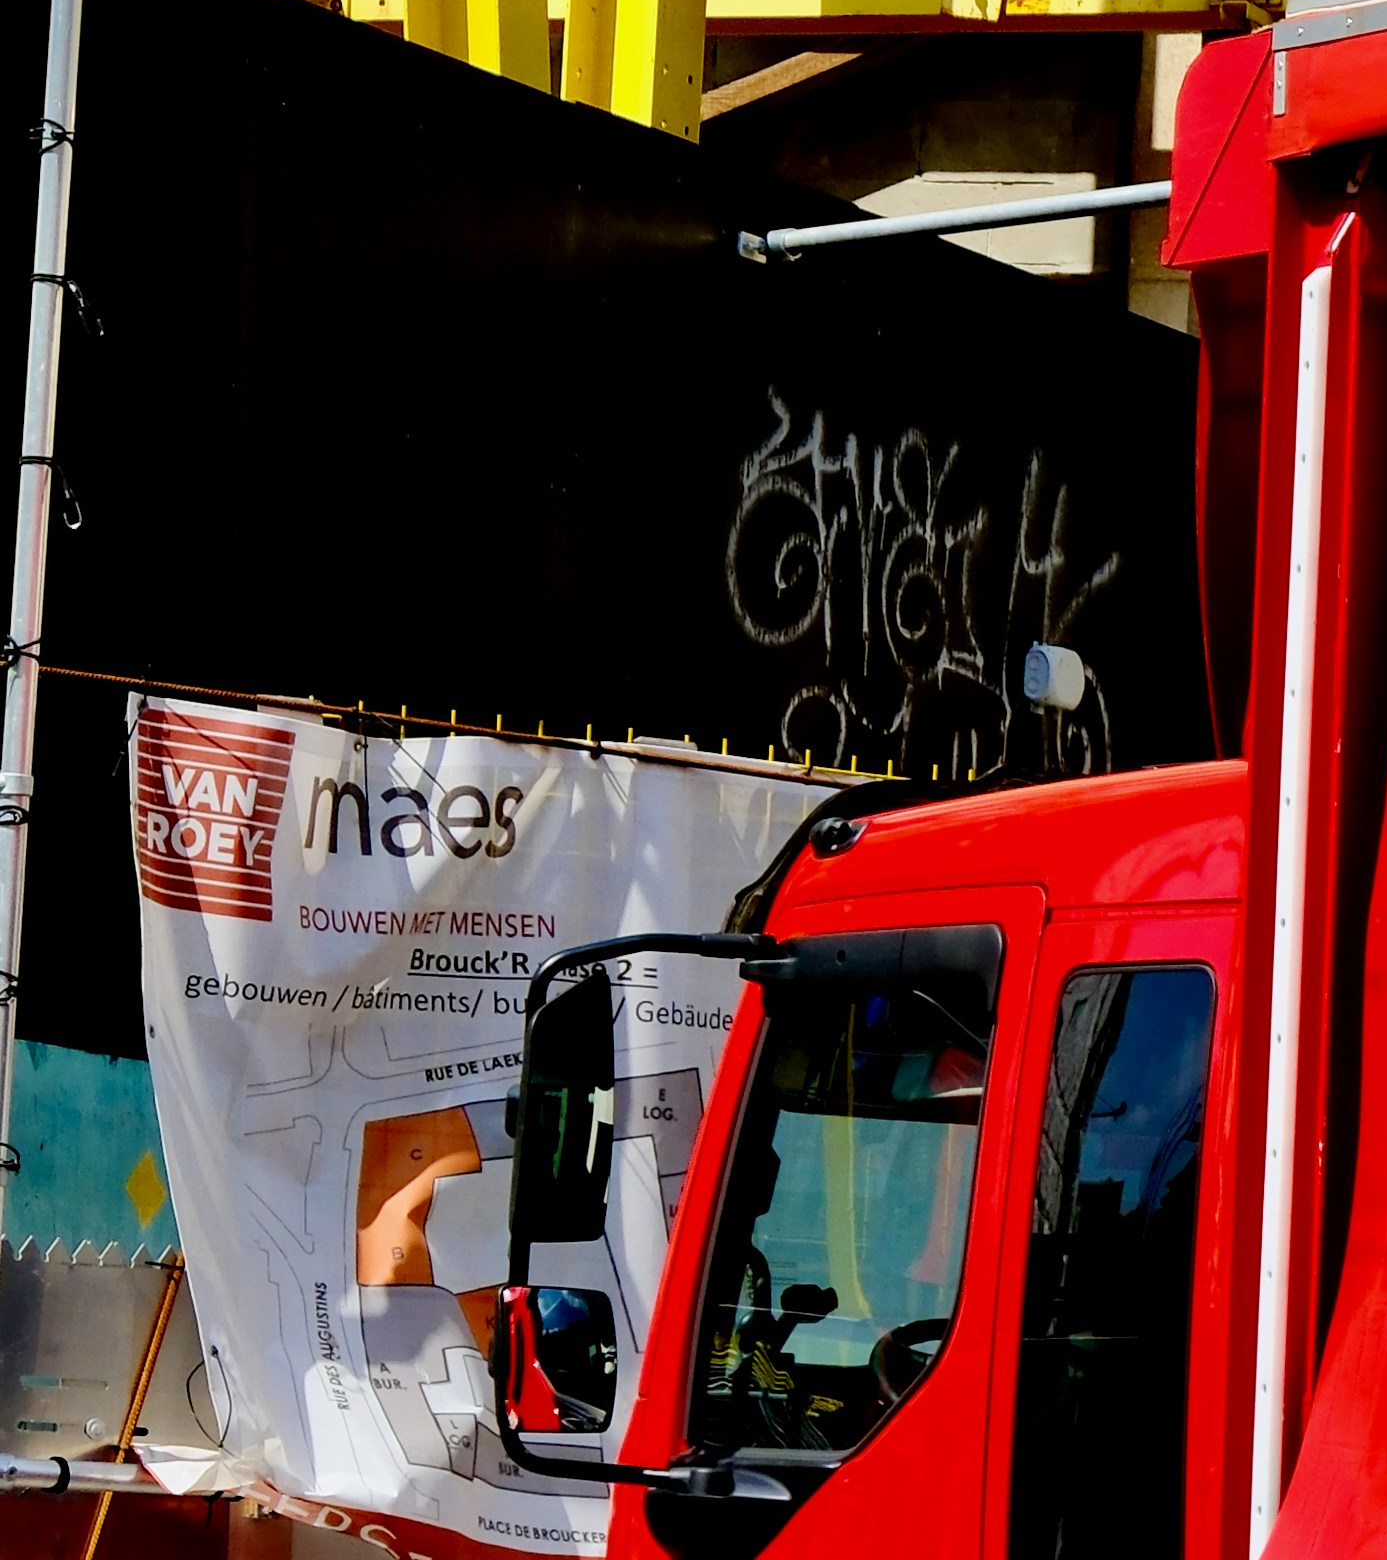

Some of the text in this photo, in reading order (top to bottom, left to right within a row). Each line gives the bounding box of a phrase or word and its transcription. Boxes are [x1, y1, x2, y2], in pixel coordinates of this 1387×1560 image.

[161, 765, 258, 817] VAN
[304, 776, 523, 859] maes
[147, 812, 264, 866] ROEY
[300, 906, 556, 938] BOUWEN MET MENSEN
[616, 959, 632, 981] 2
[185, 973, 327, 1007] gebouwen
[493, 991, 529, 1016] bu
[635, 999, 734, 1031] Gebäude
[425, 1051, 524, 1082] RUE DE LAEK
[658, 1088, 667, 1102] E
[643, 1106, 678, 1121] LOG.
[410, 1148, 423, 1161] C
[315, 1282, 350, 1411] RUE DES AUGUSTINS
[379, 1362, 391, 1374] A
[372, 1378, 408, 1391] BUR.
[477, 1516, 607, 1544] PLACE DE BROUCKER
